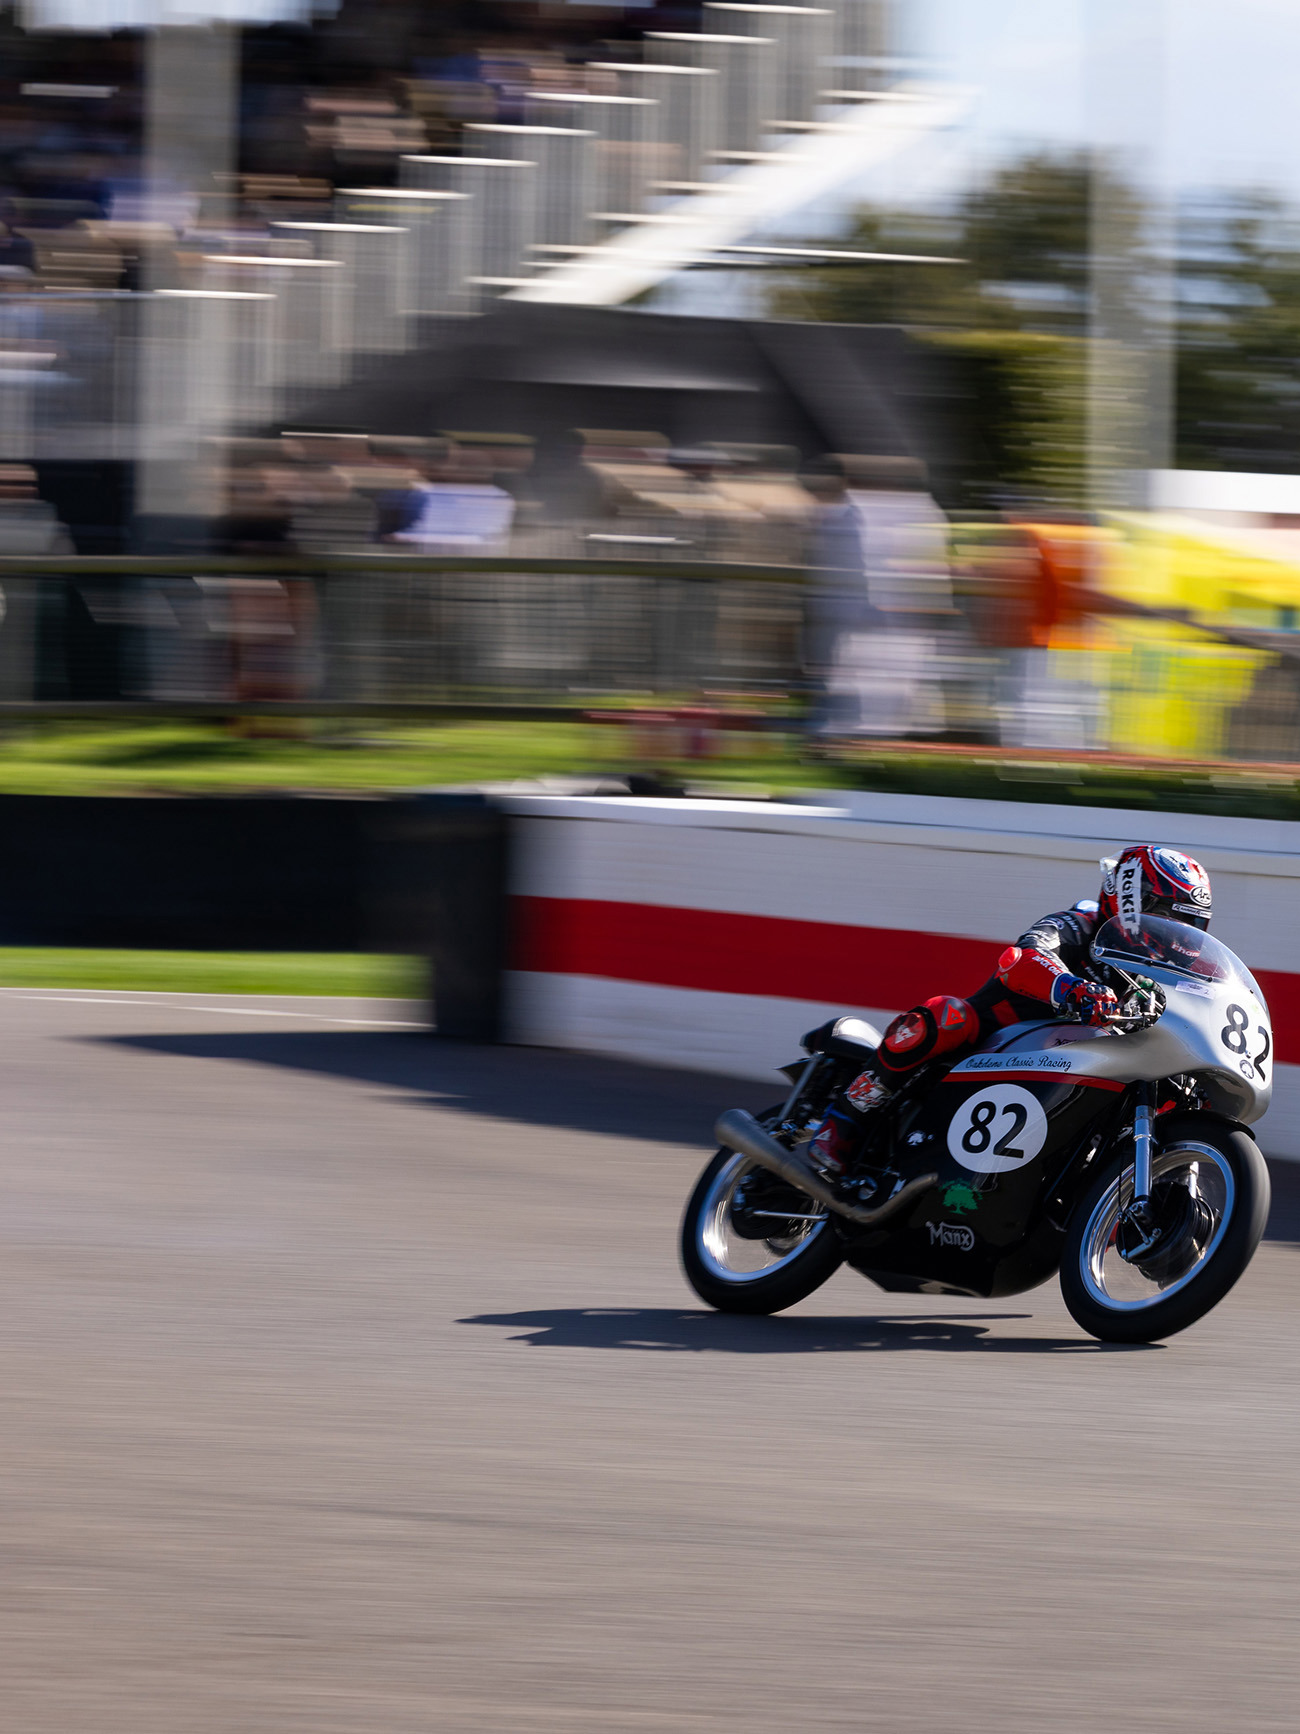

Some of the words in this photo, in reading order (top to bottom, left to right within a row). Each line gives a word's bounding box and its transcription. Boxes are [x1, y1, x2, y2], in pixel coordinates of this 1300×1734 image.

[965, 1057, 1002, 1069] Oakdene
[1006, 1056, 1034, 1067] Classic
[1037, 1055, 1072, 1073] Racing
[1221, 1003, 1270, 1082] 82
[962, 1100, 1028, 1159] 82
[925, 1220, 976, 1252] Manx
